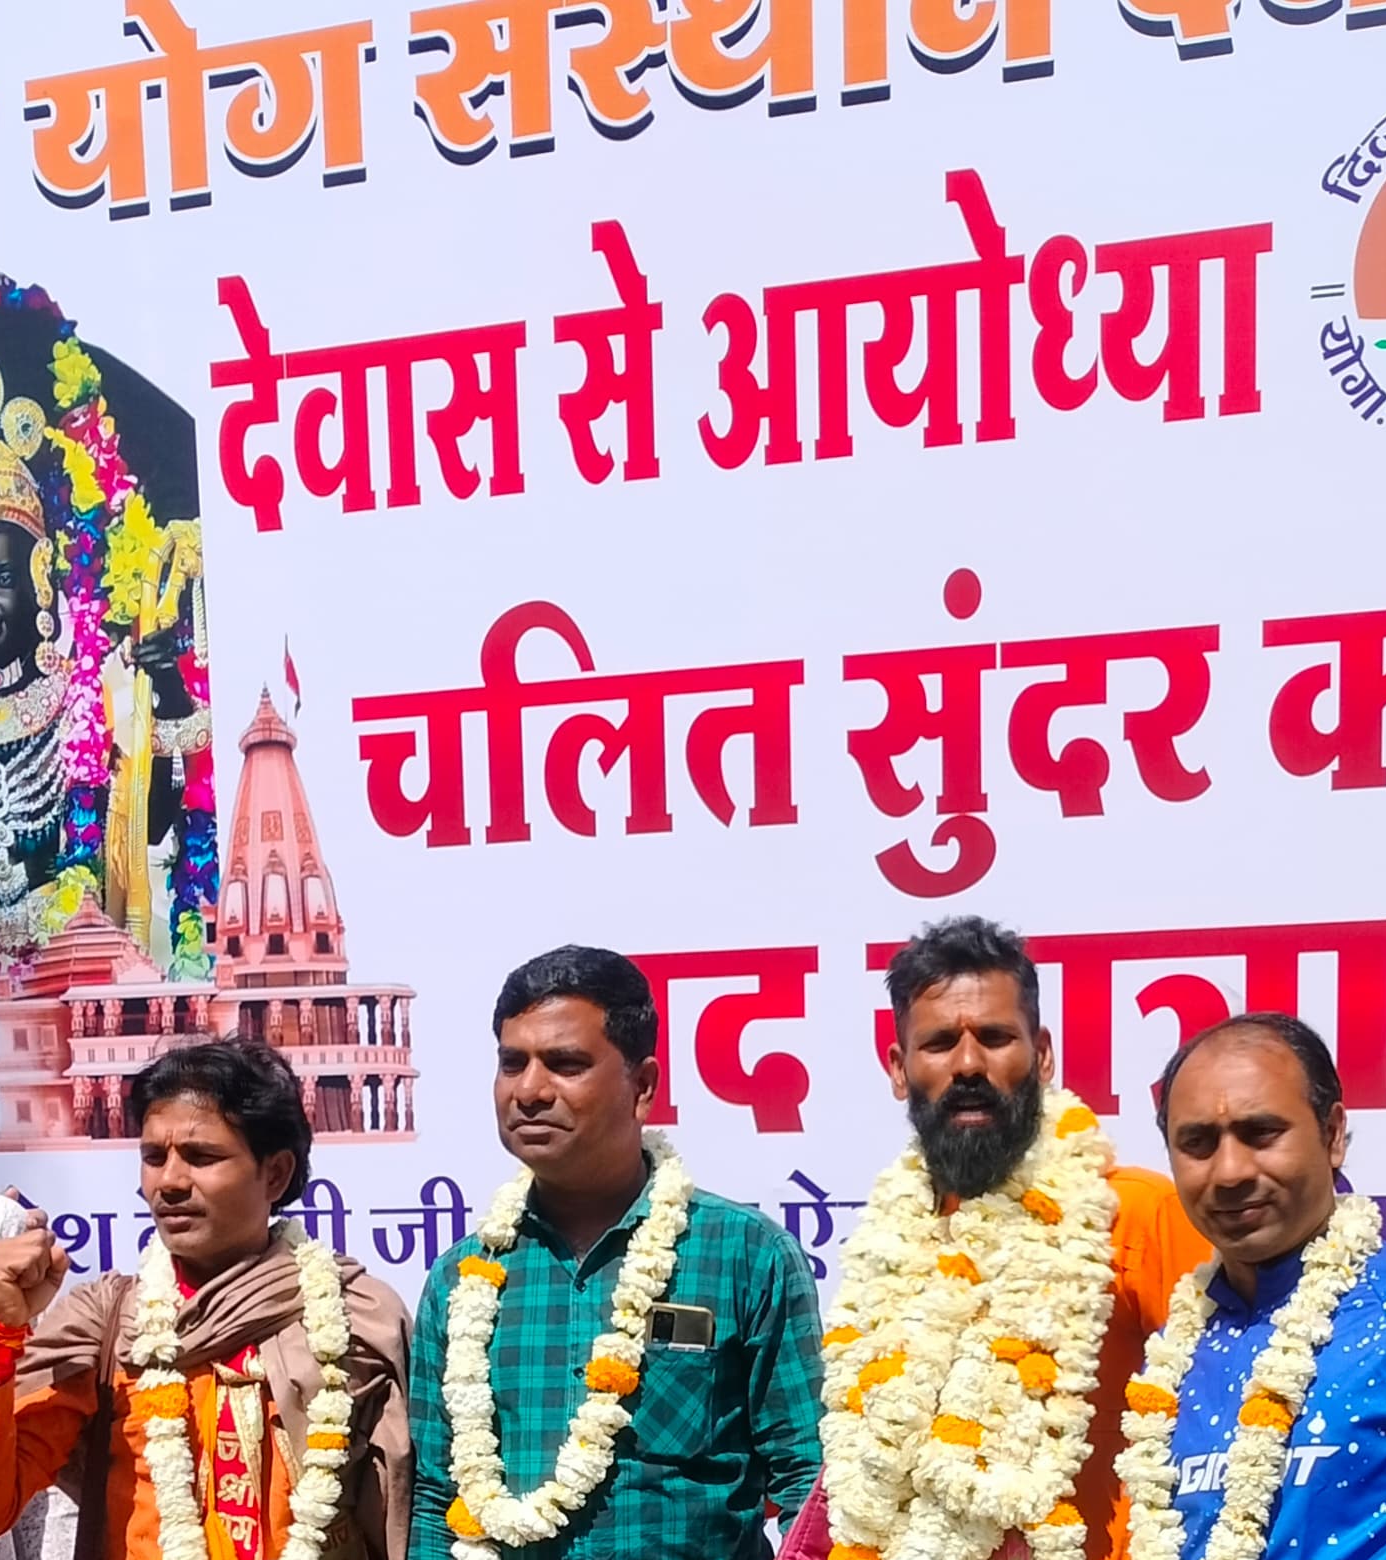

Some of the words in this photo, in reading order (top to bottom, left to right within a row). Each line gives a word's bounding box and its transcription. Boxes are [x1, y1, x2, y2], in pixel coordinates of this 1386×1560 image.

[24, 0, 376, 220] योग
[210, 275, 527, 532] देवास
[553, 220, 663, 484] से
[697, 168, 1274, 470] आयोध्या
[351, 600, 805, 848] चलित
[842, 568, 1220, 898] सुंदर
